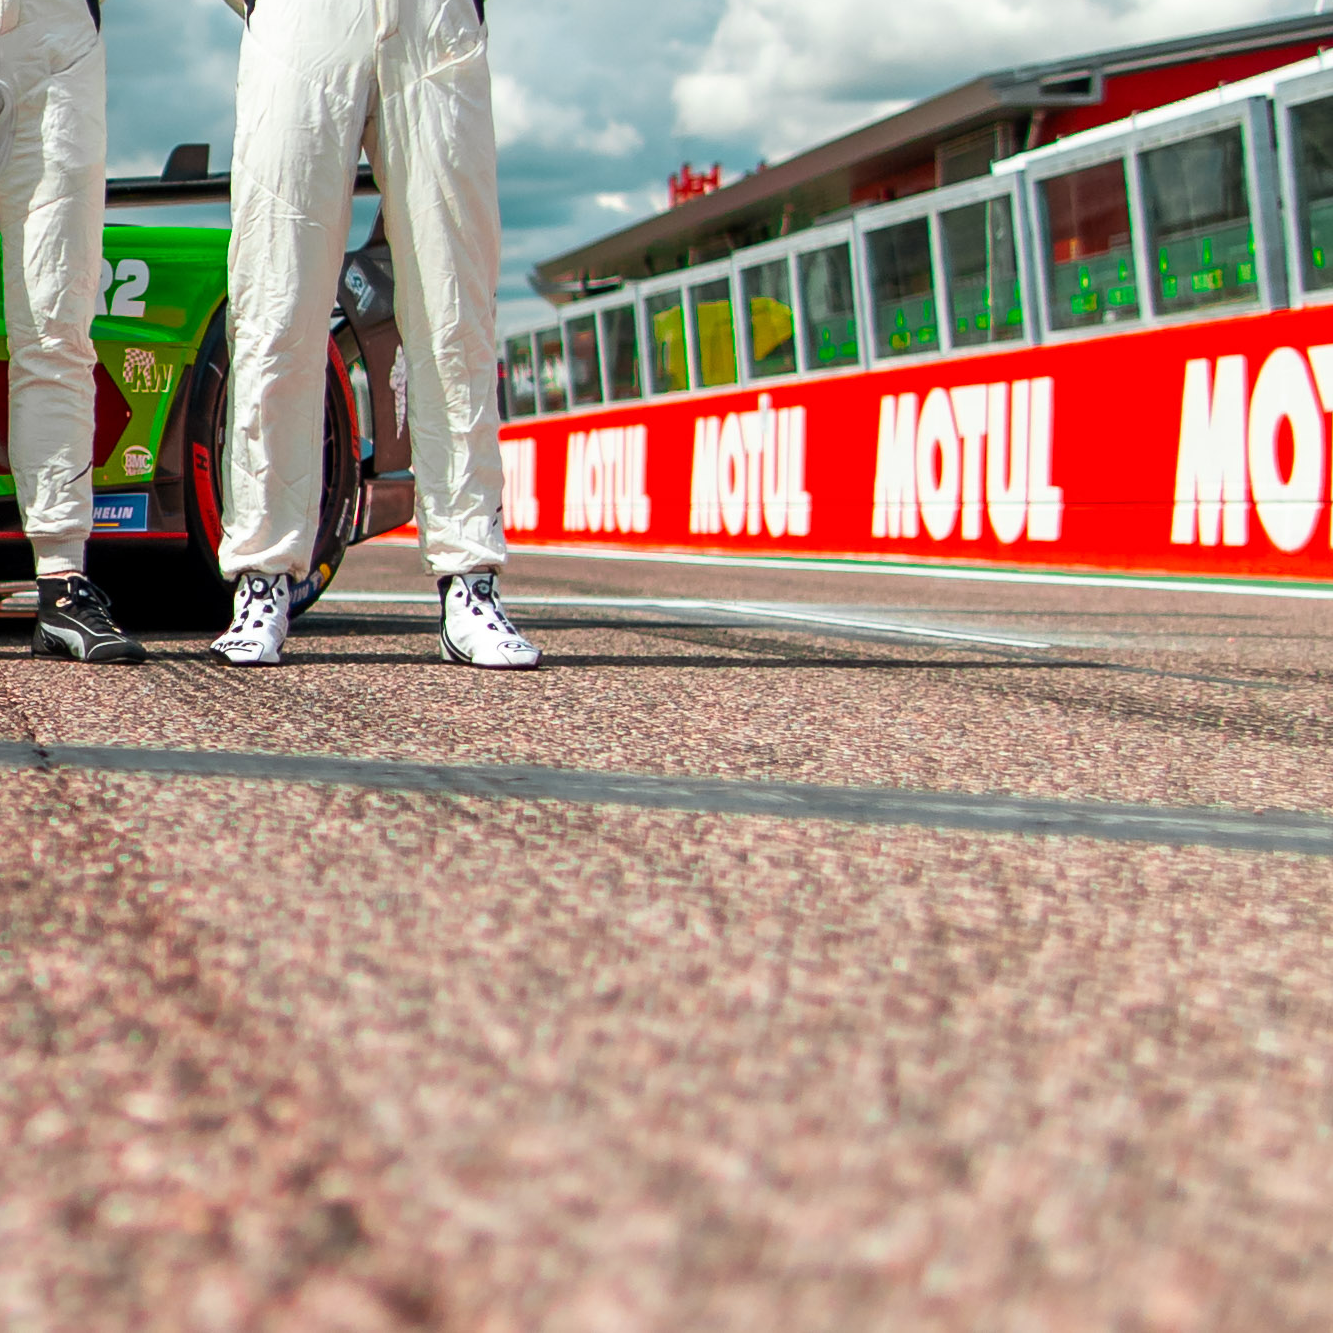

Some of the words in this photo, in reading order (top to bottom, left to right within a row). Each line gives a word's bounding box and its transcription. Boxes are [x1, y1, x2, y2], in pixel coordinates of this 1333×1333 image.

[130, 363, 174, 393] KW
[125, 453, 152, 470] BMC
[499, 437, 539, 532] TUL
[563, 423, 651, 534] MOTUL
[689, 404, 812, 538] MOTUL
[871, 375, 1063, 544] MOTUL
[92, 506, 134, 520] HELIN
